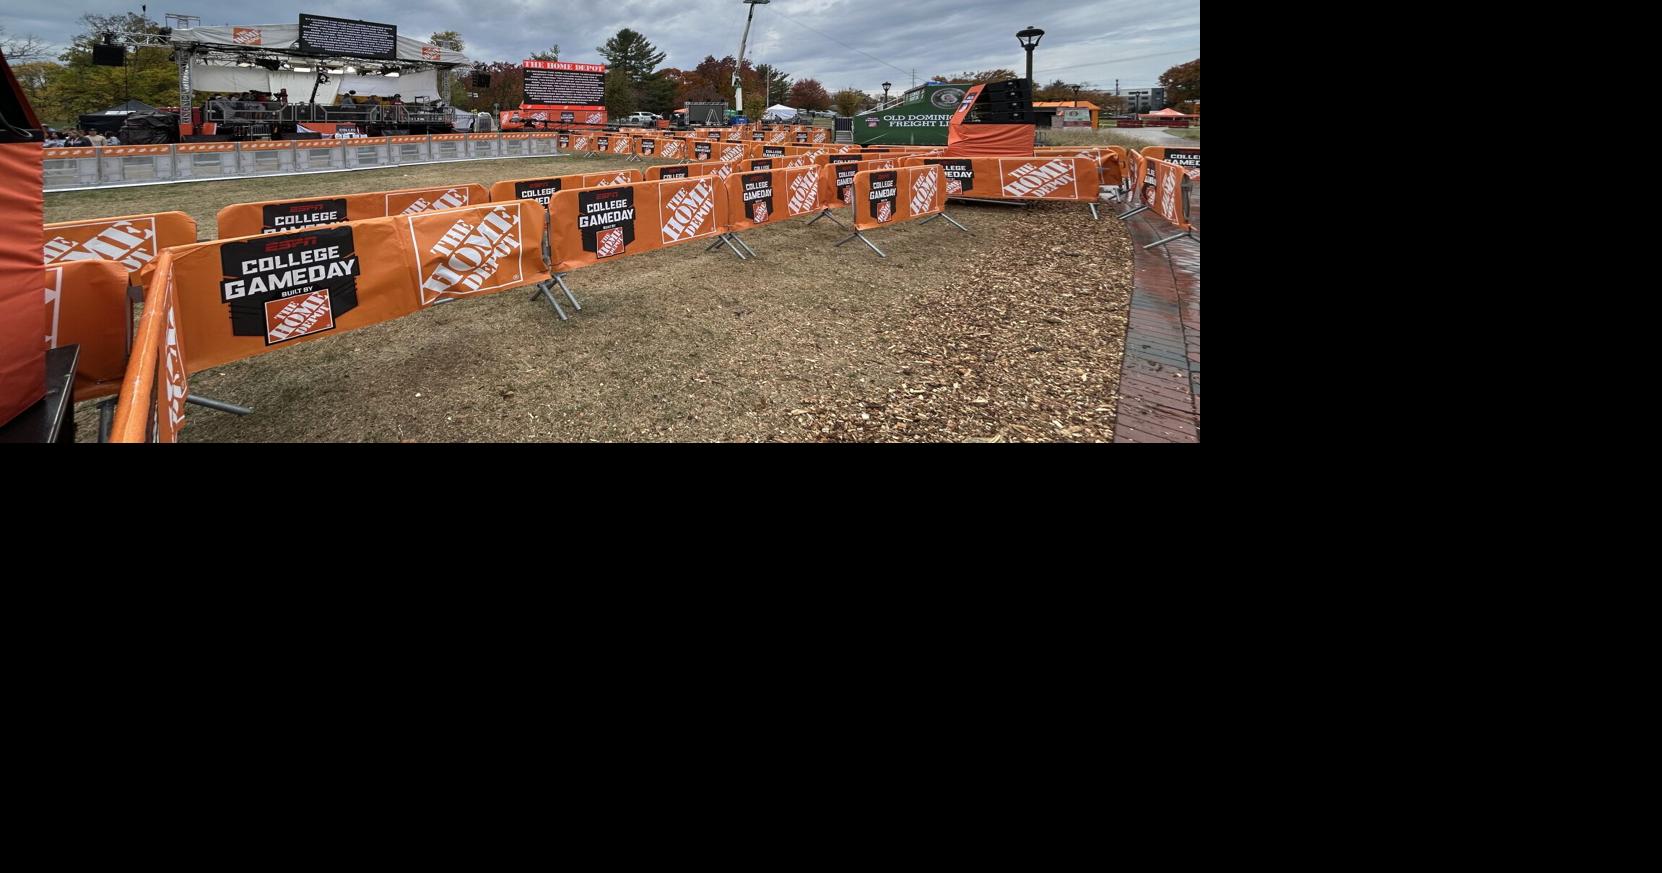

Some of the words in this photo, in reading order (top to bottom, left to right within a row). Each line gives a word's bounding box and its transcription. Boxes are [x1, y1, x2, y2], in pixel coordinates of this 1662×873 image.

[525, 60, 544, 68] THE
[547, 62, 572, 70] HOME
[575, 64, 602, 72] DEPOT
[789, 173, 803, 191] THE
[1003, 156, 1073, 197] HOME
[1007, 163, 1038, 179] THE
[521, 187, 555, 198] COLLEGE
[743, 189, 772, 202] GAMEDAY
[745, 181, 769, 191] COLLEGE
[787, 167, 818, 215] HOME
[869, 188, 897, 200] GAMEDAY
[873, 180, 893, 189] COLLEGE
[910, 167, 937, 215] HOME
[1031, 174, 1074, 198] DEPOT
[586, 199, 628, 213] COLLEGE
[662, 178, 713, 241] HOME
[665, 187, 689, 212] THE
[274, 211, 338, 226] COLLEGE
[579, 208, 634, 228] GAMEDAY
[684, 197, 714, 238] DEPOT
[265, 236, 318, 252] ESPN
[422, 205, 520, 293] HOME
[430, 219, 475, 257] THE
[597, 227, 623, 257] HOME
[241, 246, 340, 275] COLLEGE
[461, 232, 520, 291] DEPOT
[224, 259, 356, 300] GAMEDAY
[281, 288, 302, 298] BUILT
[268, 292, 329, 340] HOME
[274, 301, 300, 320] THE
[295, 304, 330, 335] DEPOT
